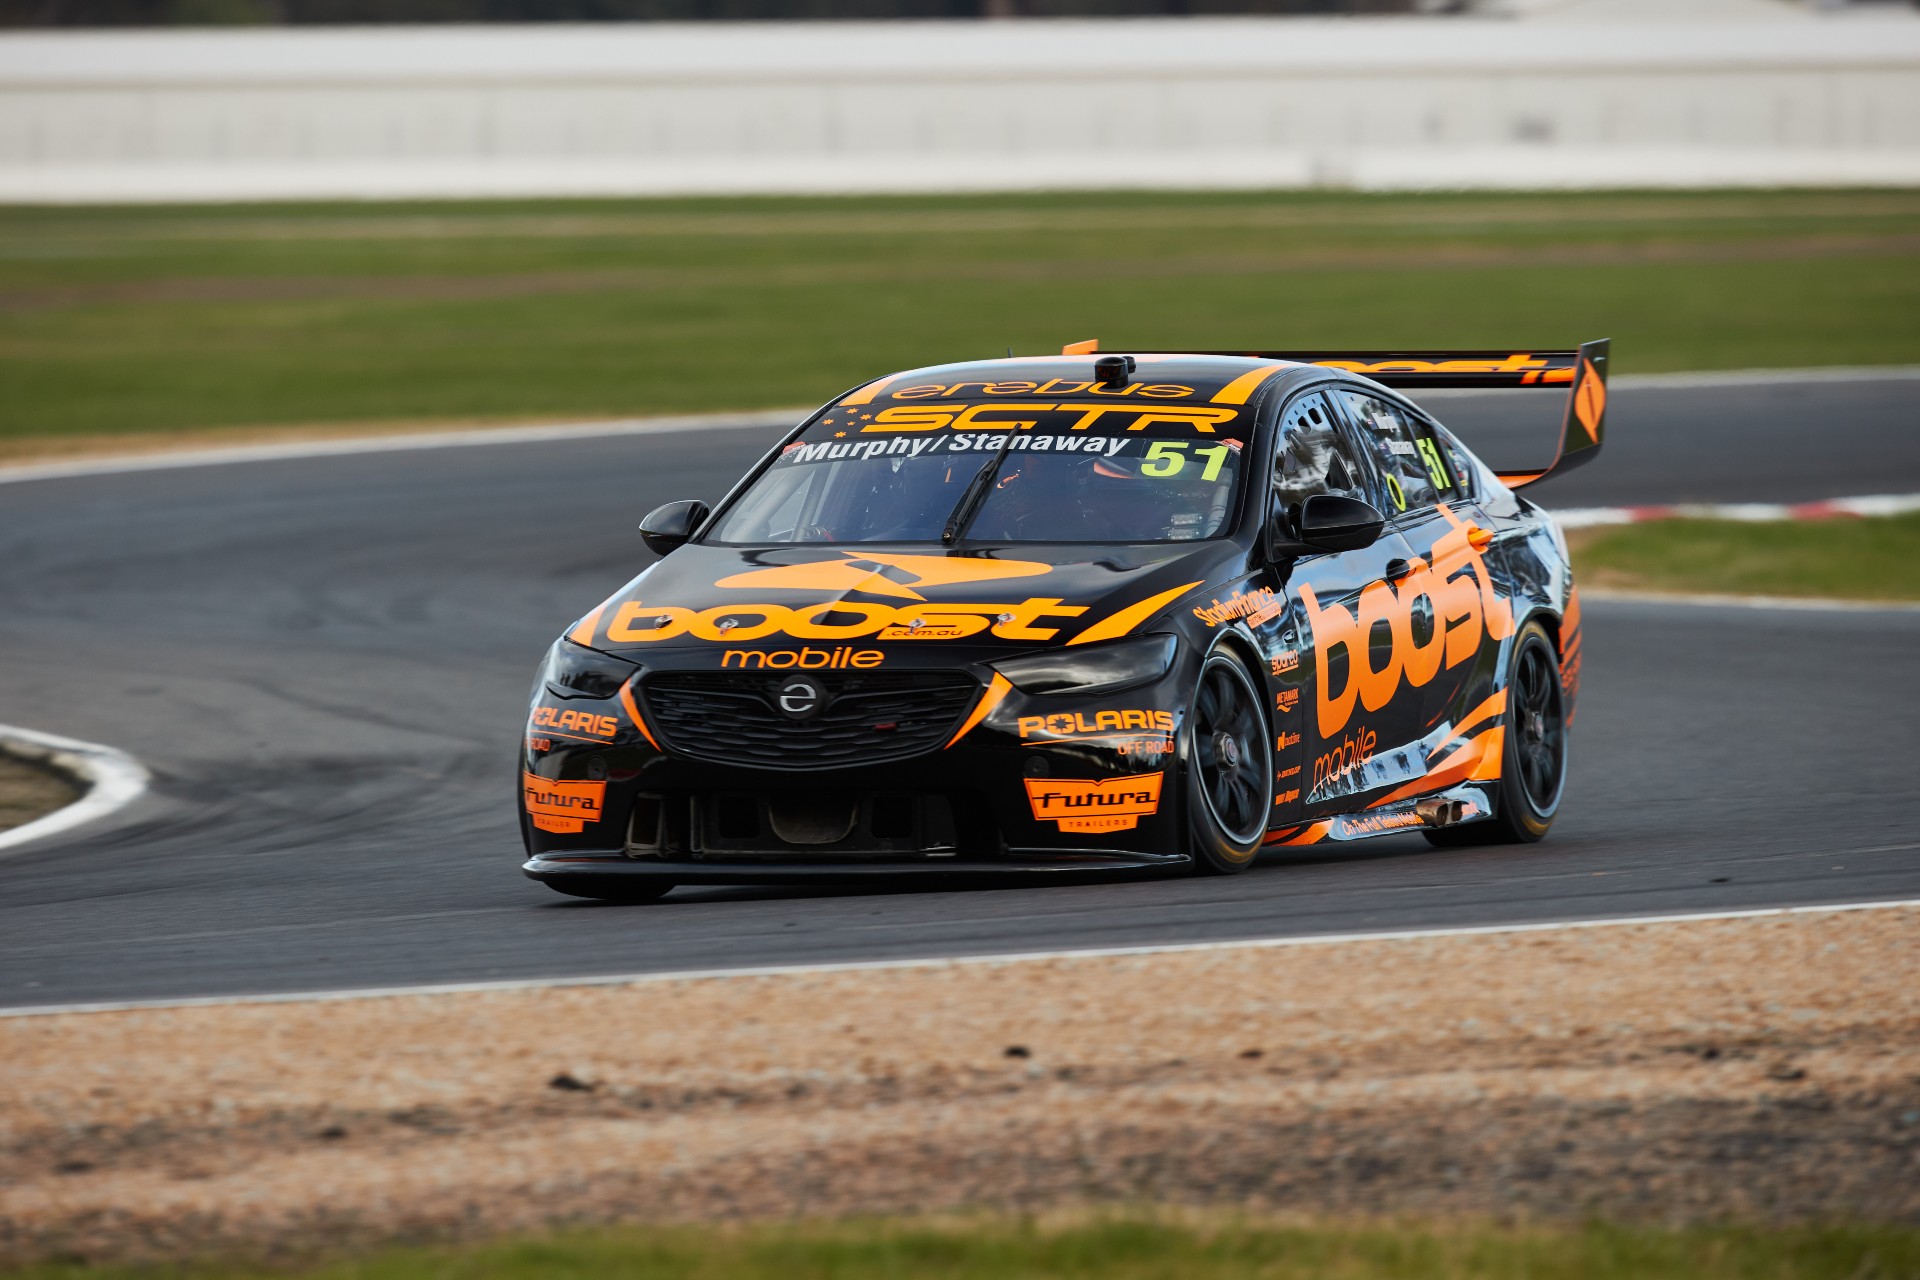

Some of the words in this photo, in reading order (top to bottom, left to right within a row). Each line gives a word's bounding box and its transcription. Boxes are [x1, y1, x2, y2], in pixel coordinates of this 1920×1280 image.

[891, 379, 1195, 400] erebus
[860, 403, 1240, 433] SCTR
[948, 433, 1132, 458] Stanaway
[1140, 441, 1230, 482] 51
[1415, 437, 1452, 490] 51
[606, 597, 1091, 642] boost
[1298, 503, 1517, 740] boost
[720, 646, 885, 669] mobile
[1017, 709, 1175, 738] POLARIS
[1117, 742, 1144, 755] OFF
[1145, 741, 1175, 754] ROAD
[1313, 725, 1377, 793] mobile
[1069, 819, 1128, 828] TRAILERS
